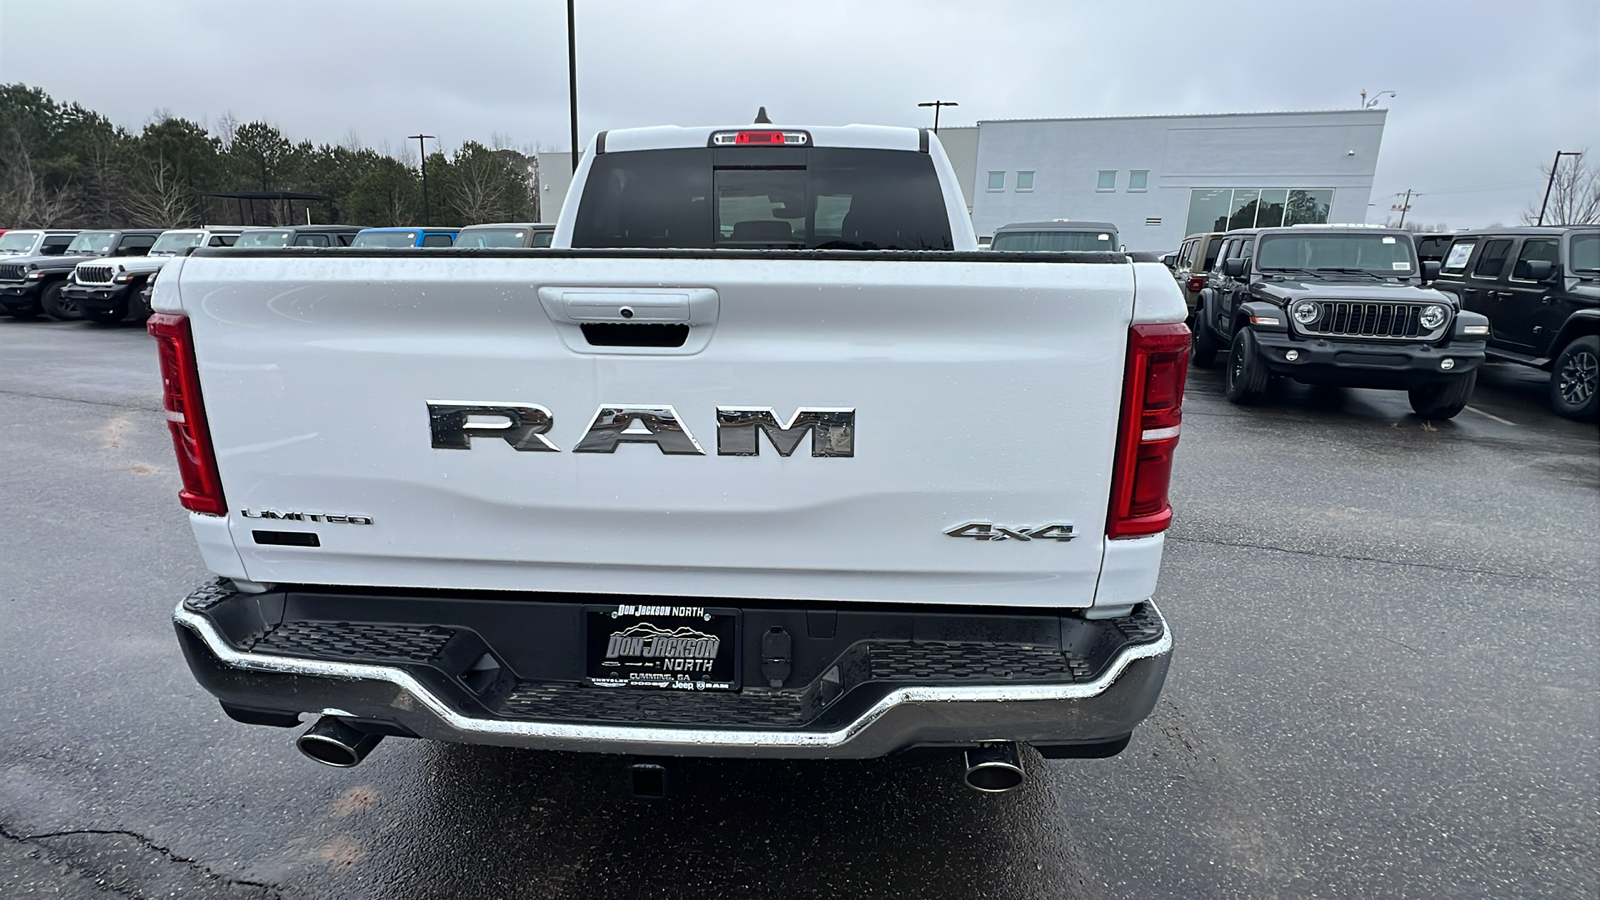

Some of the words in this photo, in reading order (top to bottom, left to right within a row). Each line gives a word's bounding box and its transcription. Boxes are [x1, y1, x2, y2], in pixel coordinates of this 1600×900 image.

[425, 399, 857, 457] RAM
[240, 508, 374, 525] LIMITED
[672, 606, 704, 617] NORTH
[663, 658, 713, 672] NORTH
[672, 681, 694, 691] Jeep
